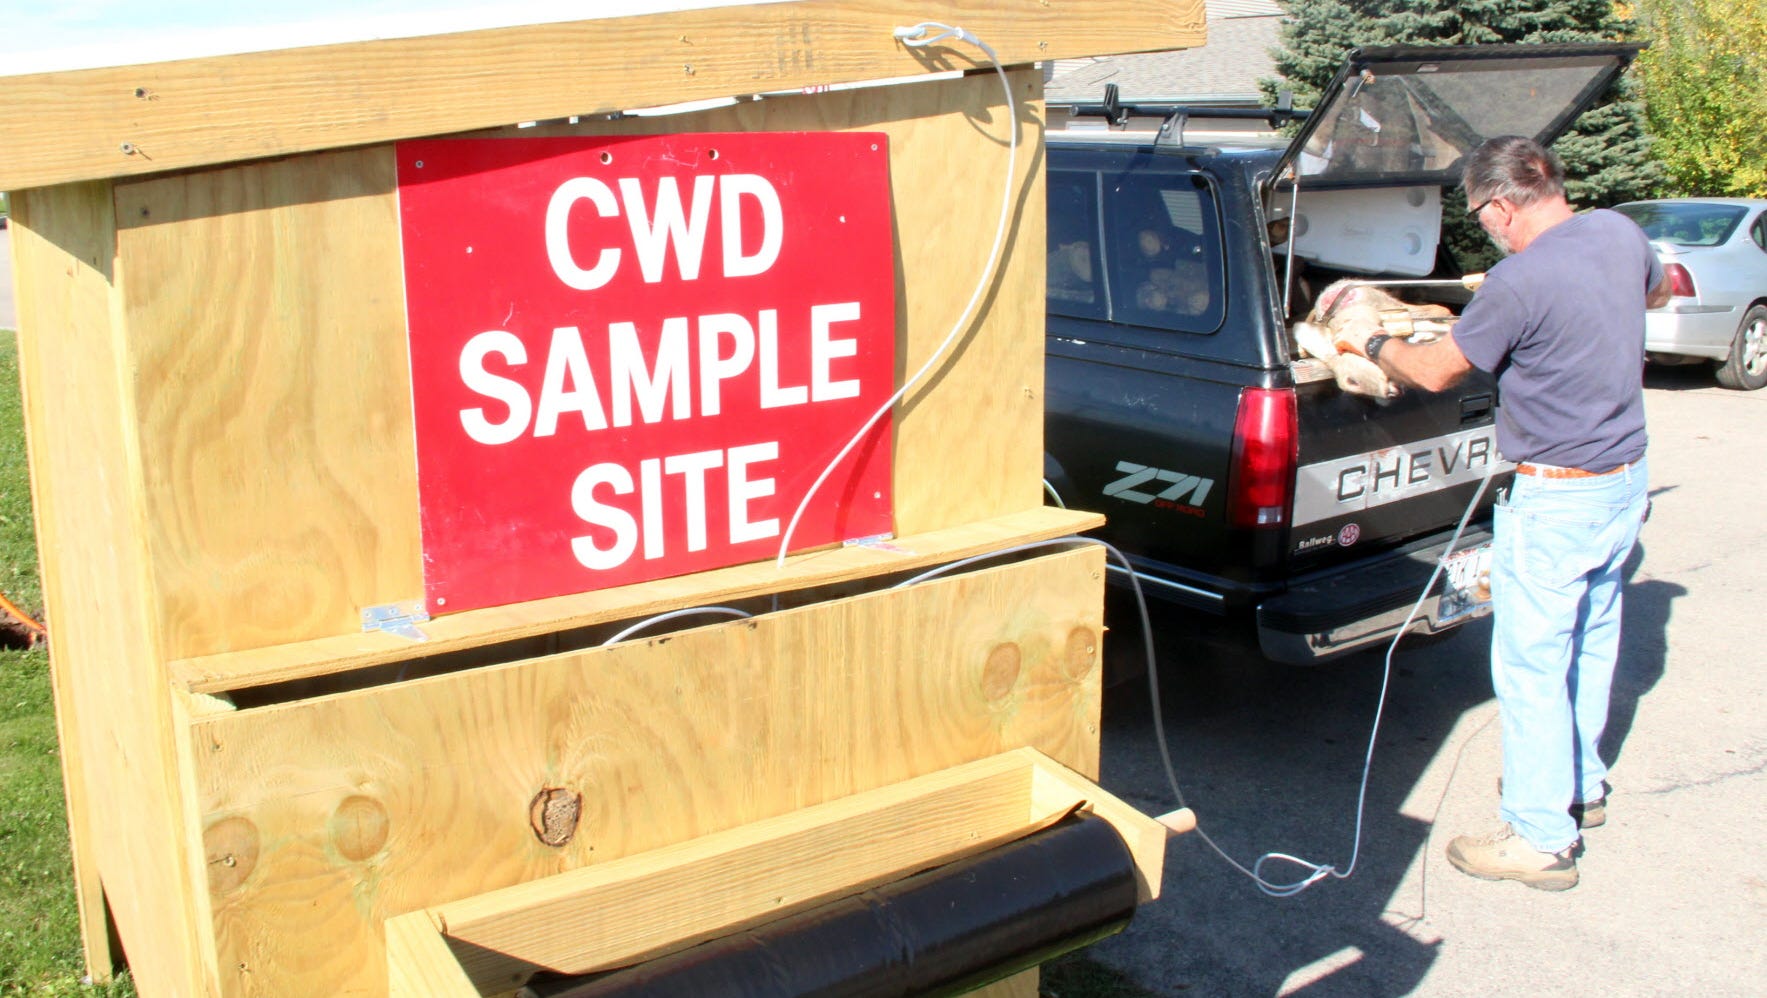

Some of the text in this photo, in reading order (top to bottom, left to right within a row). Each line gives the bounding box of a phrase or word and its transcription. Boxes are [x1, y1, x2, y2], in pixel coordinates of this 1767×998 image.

[545, 174, 784, 291] CWD
[458, 302, 861, 446] SAMPLE
[570, 441, 780, 570] SITE
[1102, 460, 1215, 507] Z71
[1337, 436, 1492, 502] CHEVR
